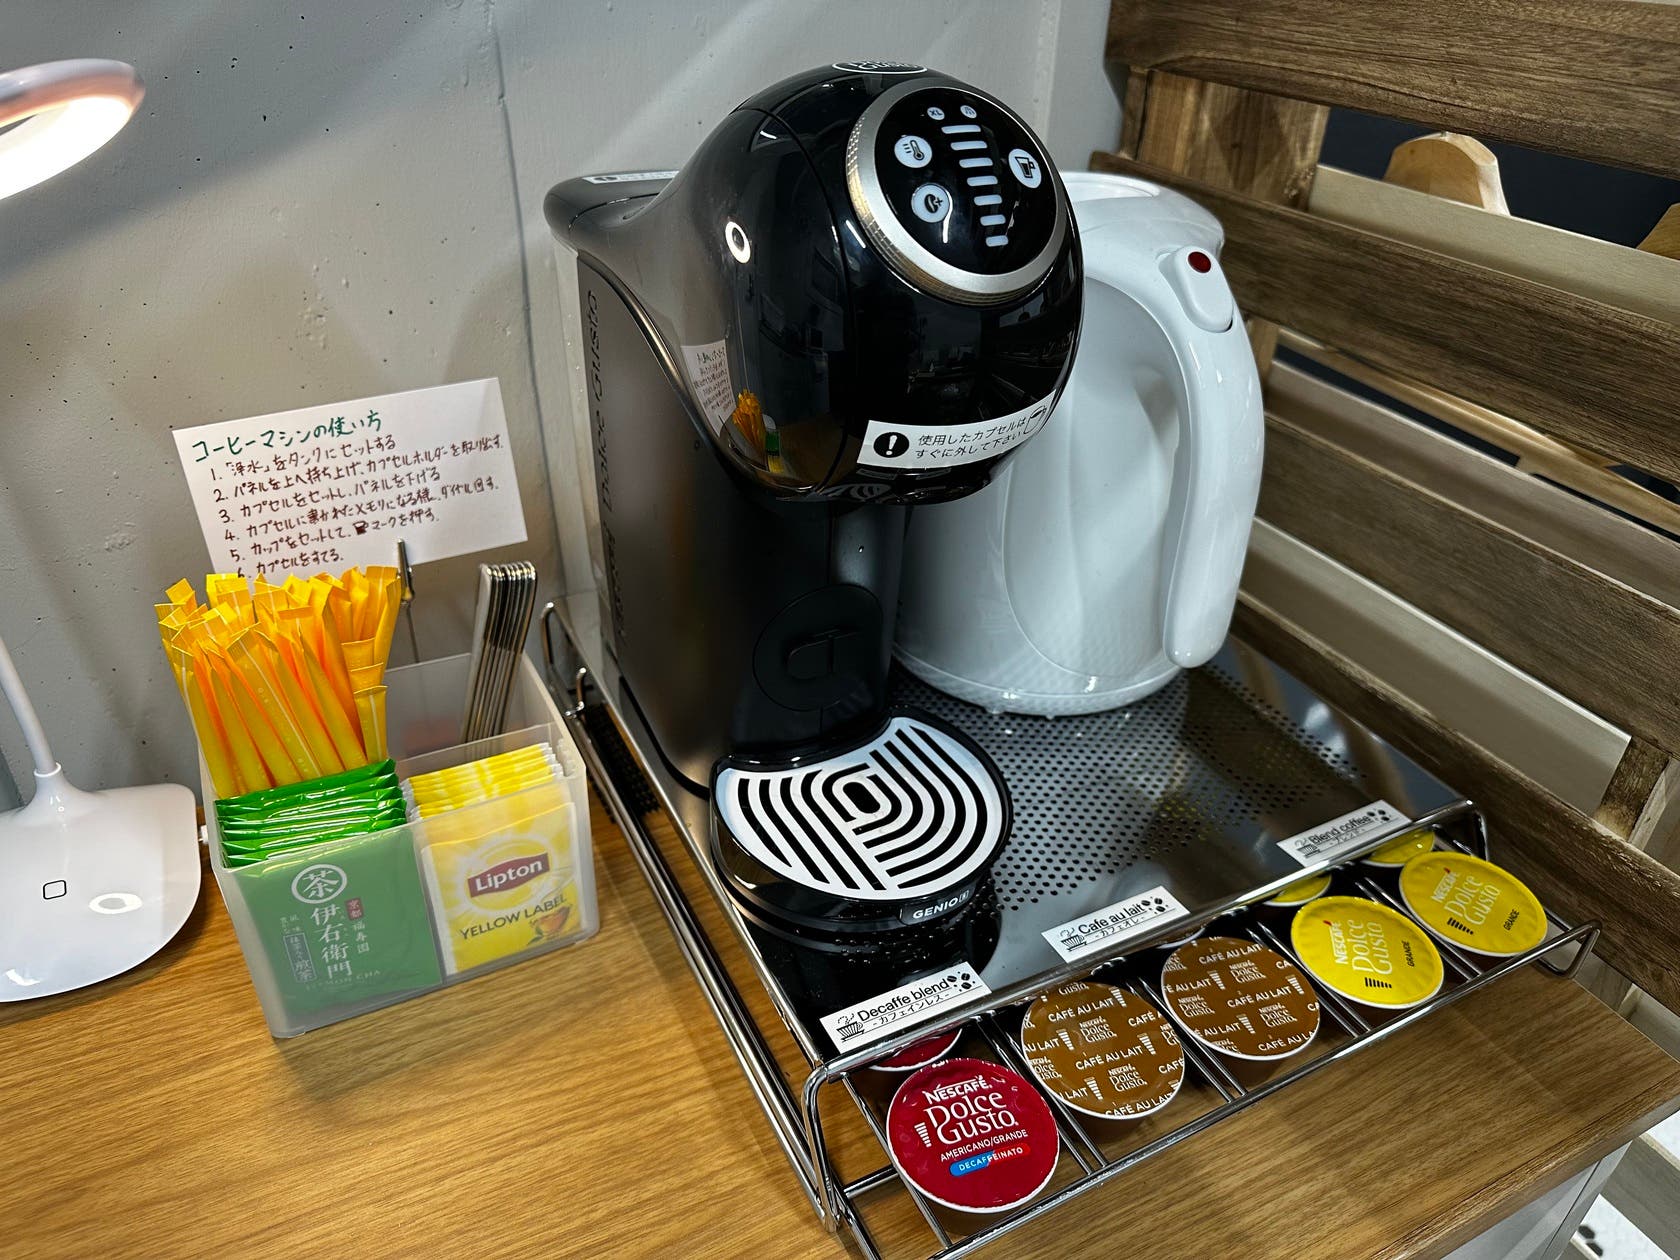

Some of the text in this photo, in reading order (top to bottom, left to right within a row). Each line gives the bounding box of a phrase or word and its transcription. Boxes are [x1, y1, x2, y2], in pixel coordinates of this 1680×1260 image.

[192, 410, 381, 462] コーヒーマシンの使い方
[918, 416, 1027, 447] 使用したカプセルは
[914, 431, 1021, 459] すぐに外して下さい
[211, 468, 223, 481] 1.
[213, 488, 229, 502] 2.
[218, 509, 235, 524] 3.
[225, 529, 240, 541] 4.
[230, 549, 245, 562] 5.
[1308, 815, 1371, 845] Blend coffee
[302, 868, 340, 900] 茶
[475, 860, 543, 892] Lipton
[912, 896, 959, 919] GENIO
[1444, 875, 1484, 917] Dolce
[1464, 884, 1501, 926] Gusto
[460, 893, 567, 940] YELLOW LABEL
[1078, 903, 1146, 935] Cafe au lait
[1503, 908, 1521, 931] GRANDE
[310, 903, 353, 979] 伊右衛門
[1199, 943, 1263, 965] CAFÉ AU LAIT
[1347, 918, 1374, 973] Dolce
[1367, 921, 1393, 976] Gusto
[1401, 939, 1415, 968] GRANDE
[1175, 982, 1190, 993] AU
[1190, 977, 1212, 990] LAIT
[1227, 986, 1292, 1008] CAFÉ AU LAIT
[857, 978, 951, 1022] Decaffe blend
[1048, 1007, 1076, 1022] CAFÉ
[1077, 1002, 1094, 1017] AU
[1094, 997, 1115, 1011] LAIT
[1128, 1010, 1156, 1027] CAFÉ
[1204, 1026, 1218, 1036] AU
[1219, 1021, 1241, 1033] LAIT
[1038, 1038, 1060, 1051] LAIT
[1258, 1038, 1286, 1051] CAFÉ
[1287, 1034, 1303, 1047] AU
[1033, 1062, 1055, 1074] olce
[1075, 1045, 1143, 1071] CAFÉ AU LAIT
[1037, 1070, 1062, 1081] usto
[922, 1075, 993, 1105] NESCAFÉ
[1067, 1087, 1089, 1100] LAIT
[923, 1091, 1007, 1129] Dolce
[1136, 1100, 1152, 1111] AU
[936, 1109, 1018, 1145] Gusto
[940, 1129, 1029, 1162] AMERICANO/GRANDE
[958, 1146, 1024, 1172] DECAFFEINATO
